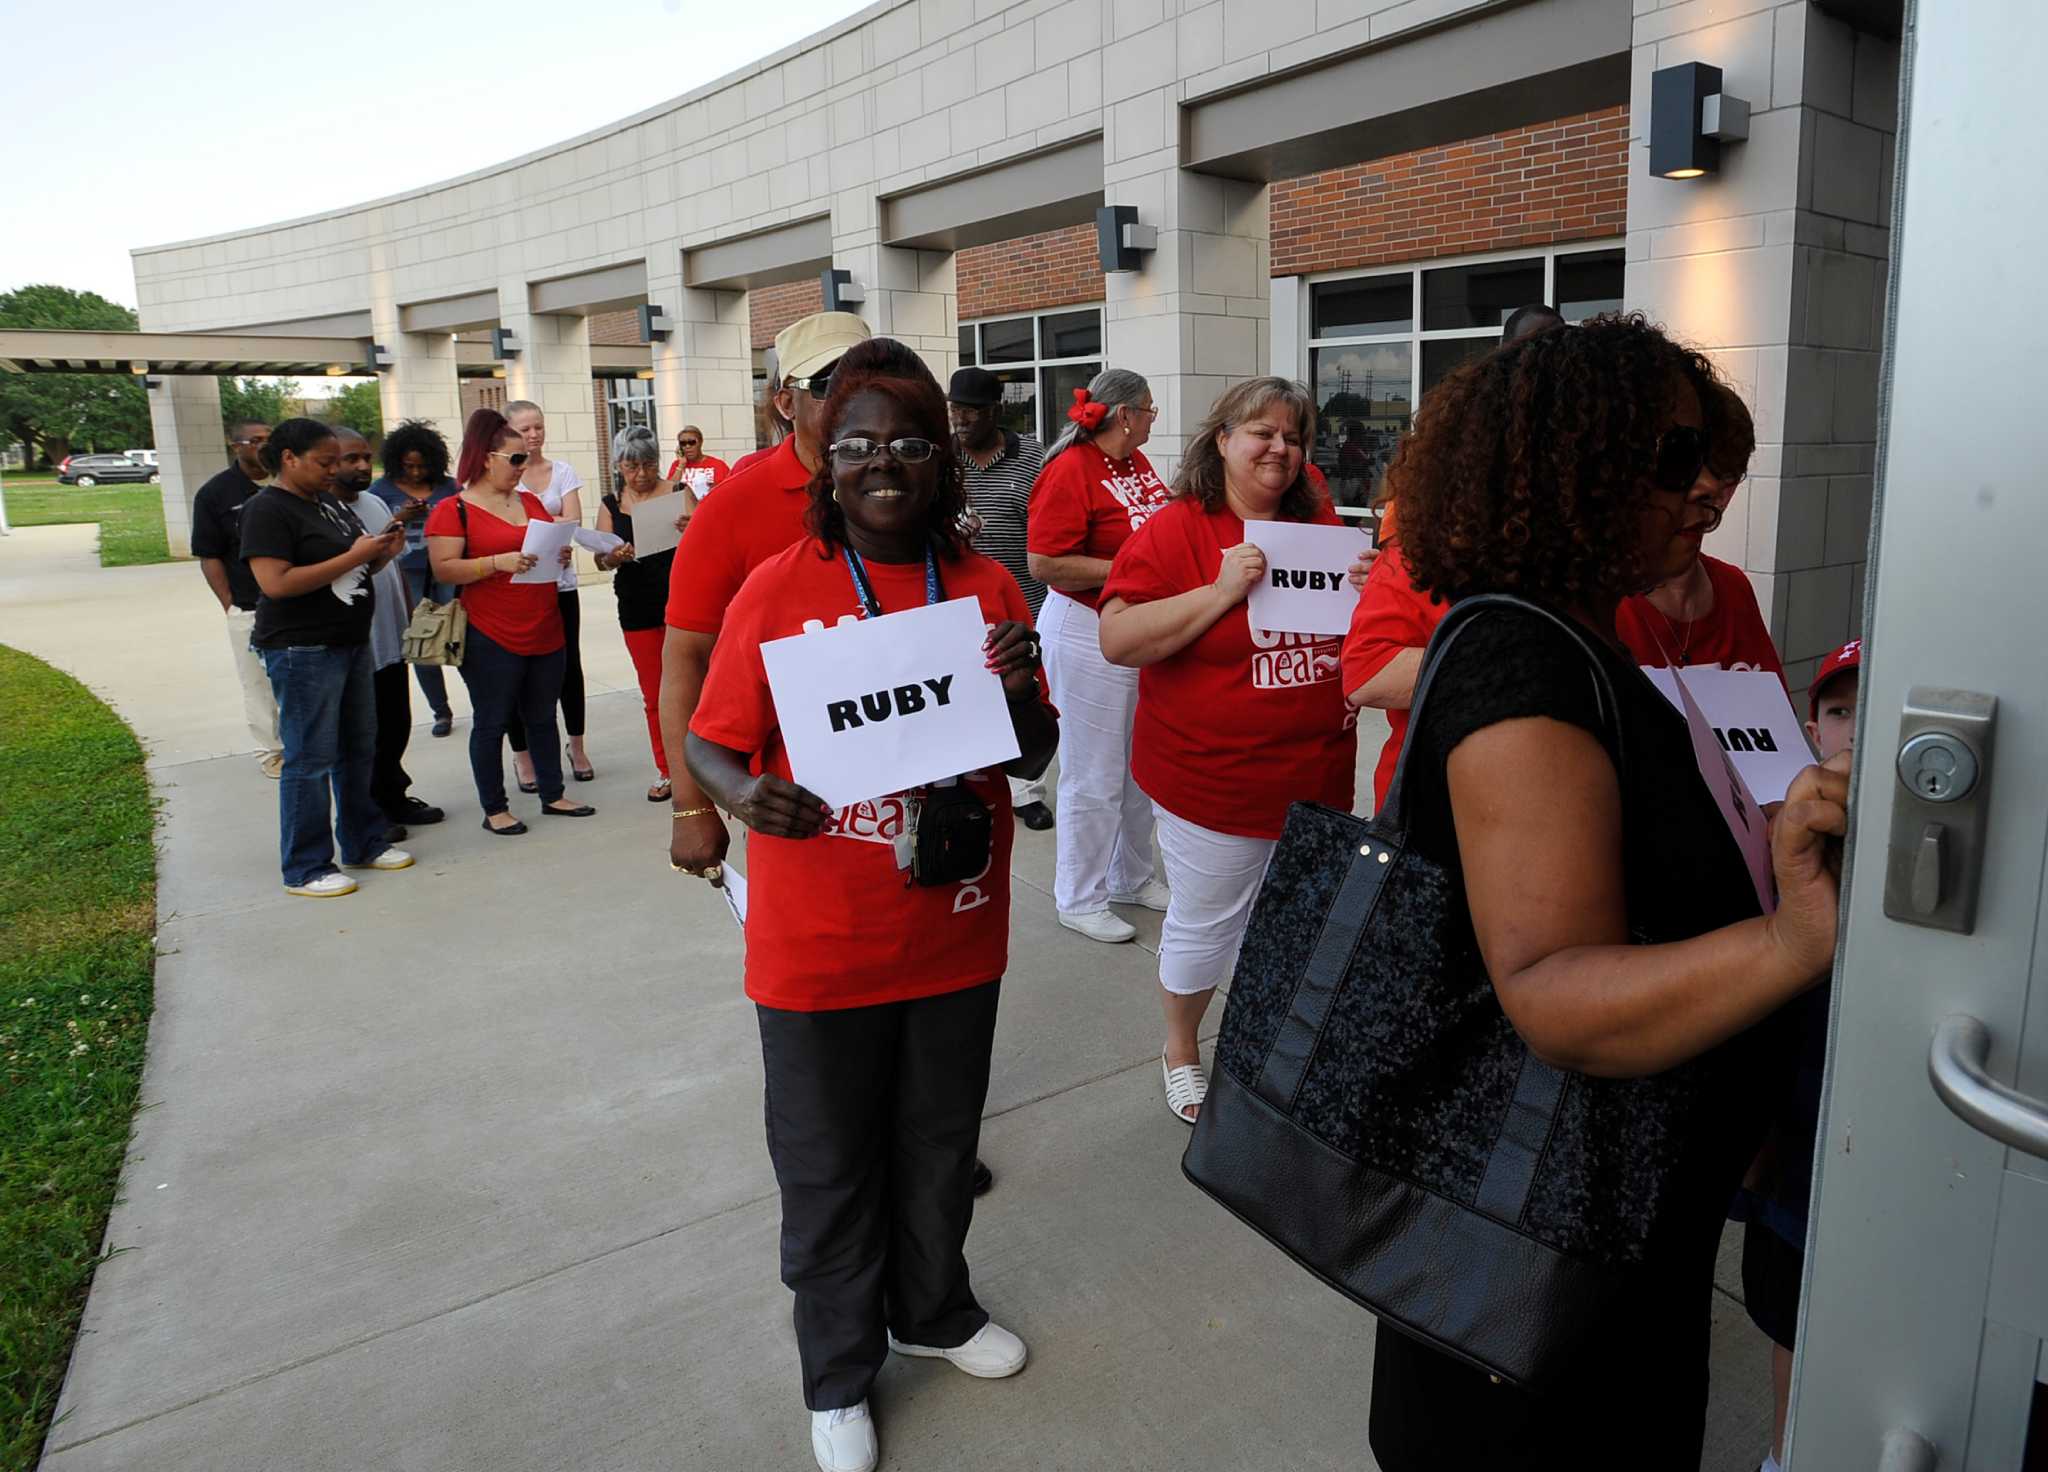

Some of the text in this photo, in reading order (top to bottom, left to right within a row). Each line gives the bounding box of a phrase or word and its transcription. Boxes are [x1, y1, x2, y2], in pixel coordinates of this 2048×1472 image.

[1272, 569, 1345, 591] RUBY
[1255, 651, 1311, 686] nea
[827, 674, 953, 732] RUBY
